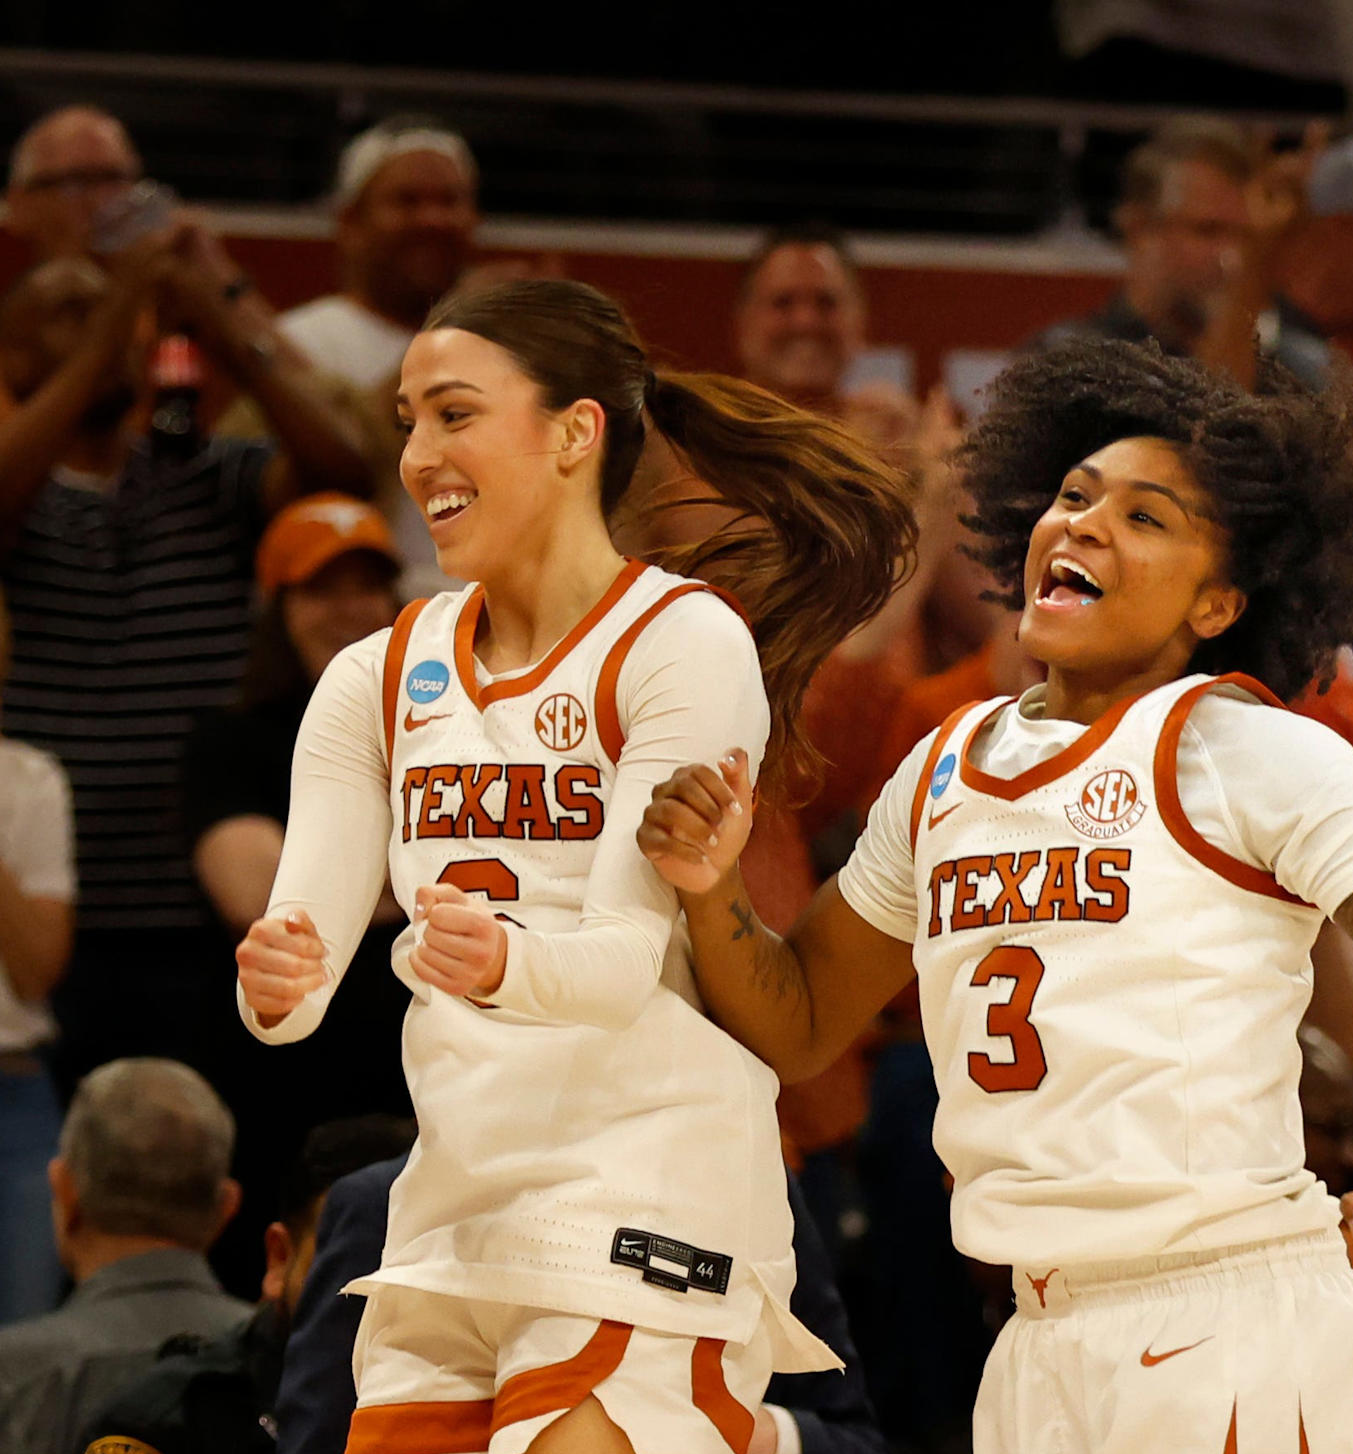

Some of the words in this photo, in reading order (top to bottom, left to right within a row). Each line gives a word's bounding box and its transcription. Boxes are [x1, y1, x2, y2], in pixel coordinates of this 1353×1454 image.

[409, 678, 446, 694] NCAA
[536, 694, 587, 750] SEC
[400, 763, 605, 844] TEXAS
[1082, 771, 1136, 822] SEC
[927, 846, 1132, 939] TEXAS
[968, 945, 1048, 1094] 3
[696, 1262, 714, 1280] 44
